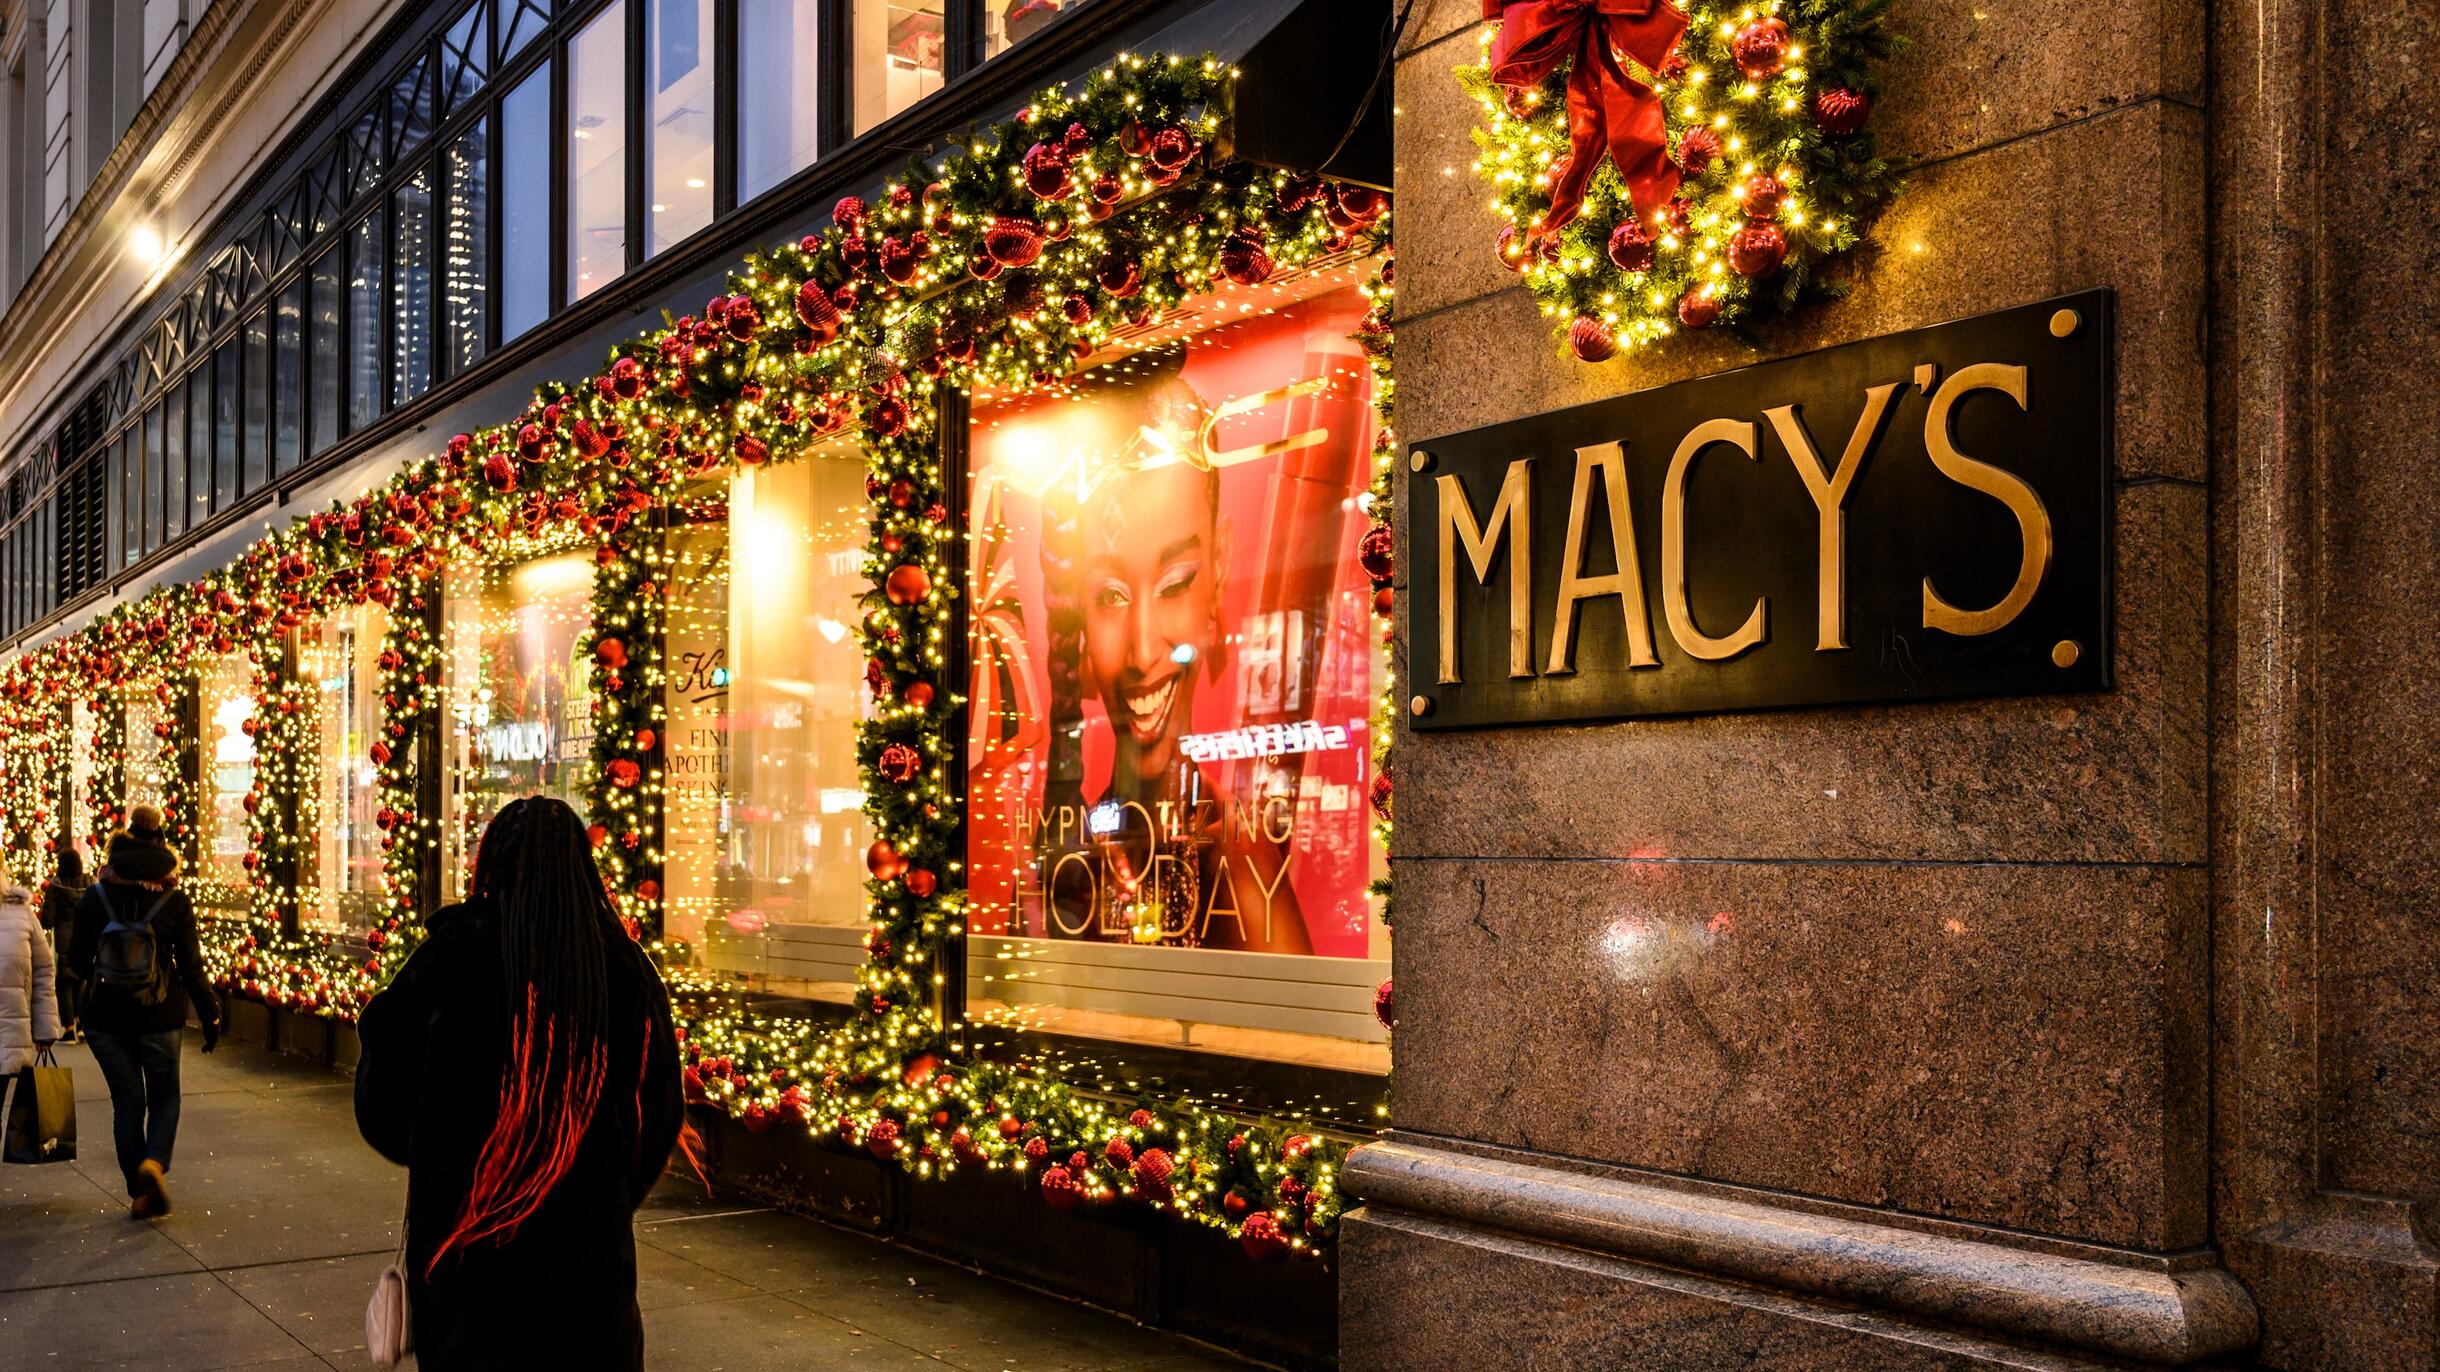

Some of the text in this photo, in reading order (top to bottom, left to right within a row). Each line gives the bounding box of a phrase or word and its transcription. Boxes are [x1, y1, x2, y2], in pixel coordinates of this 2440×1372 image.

[1435, 362, 2053, 686] MACY'S
[675, 648, 729, 694] Ki
[689, 729, 728, 748] FIN
[664, 754, 729, 774] APOTH
